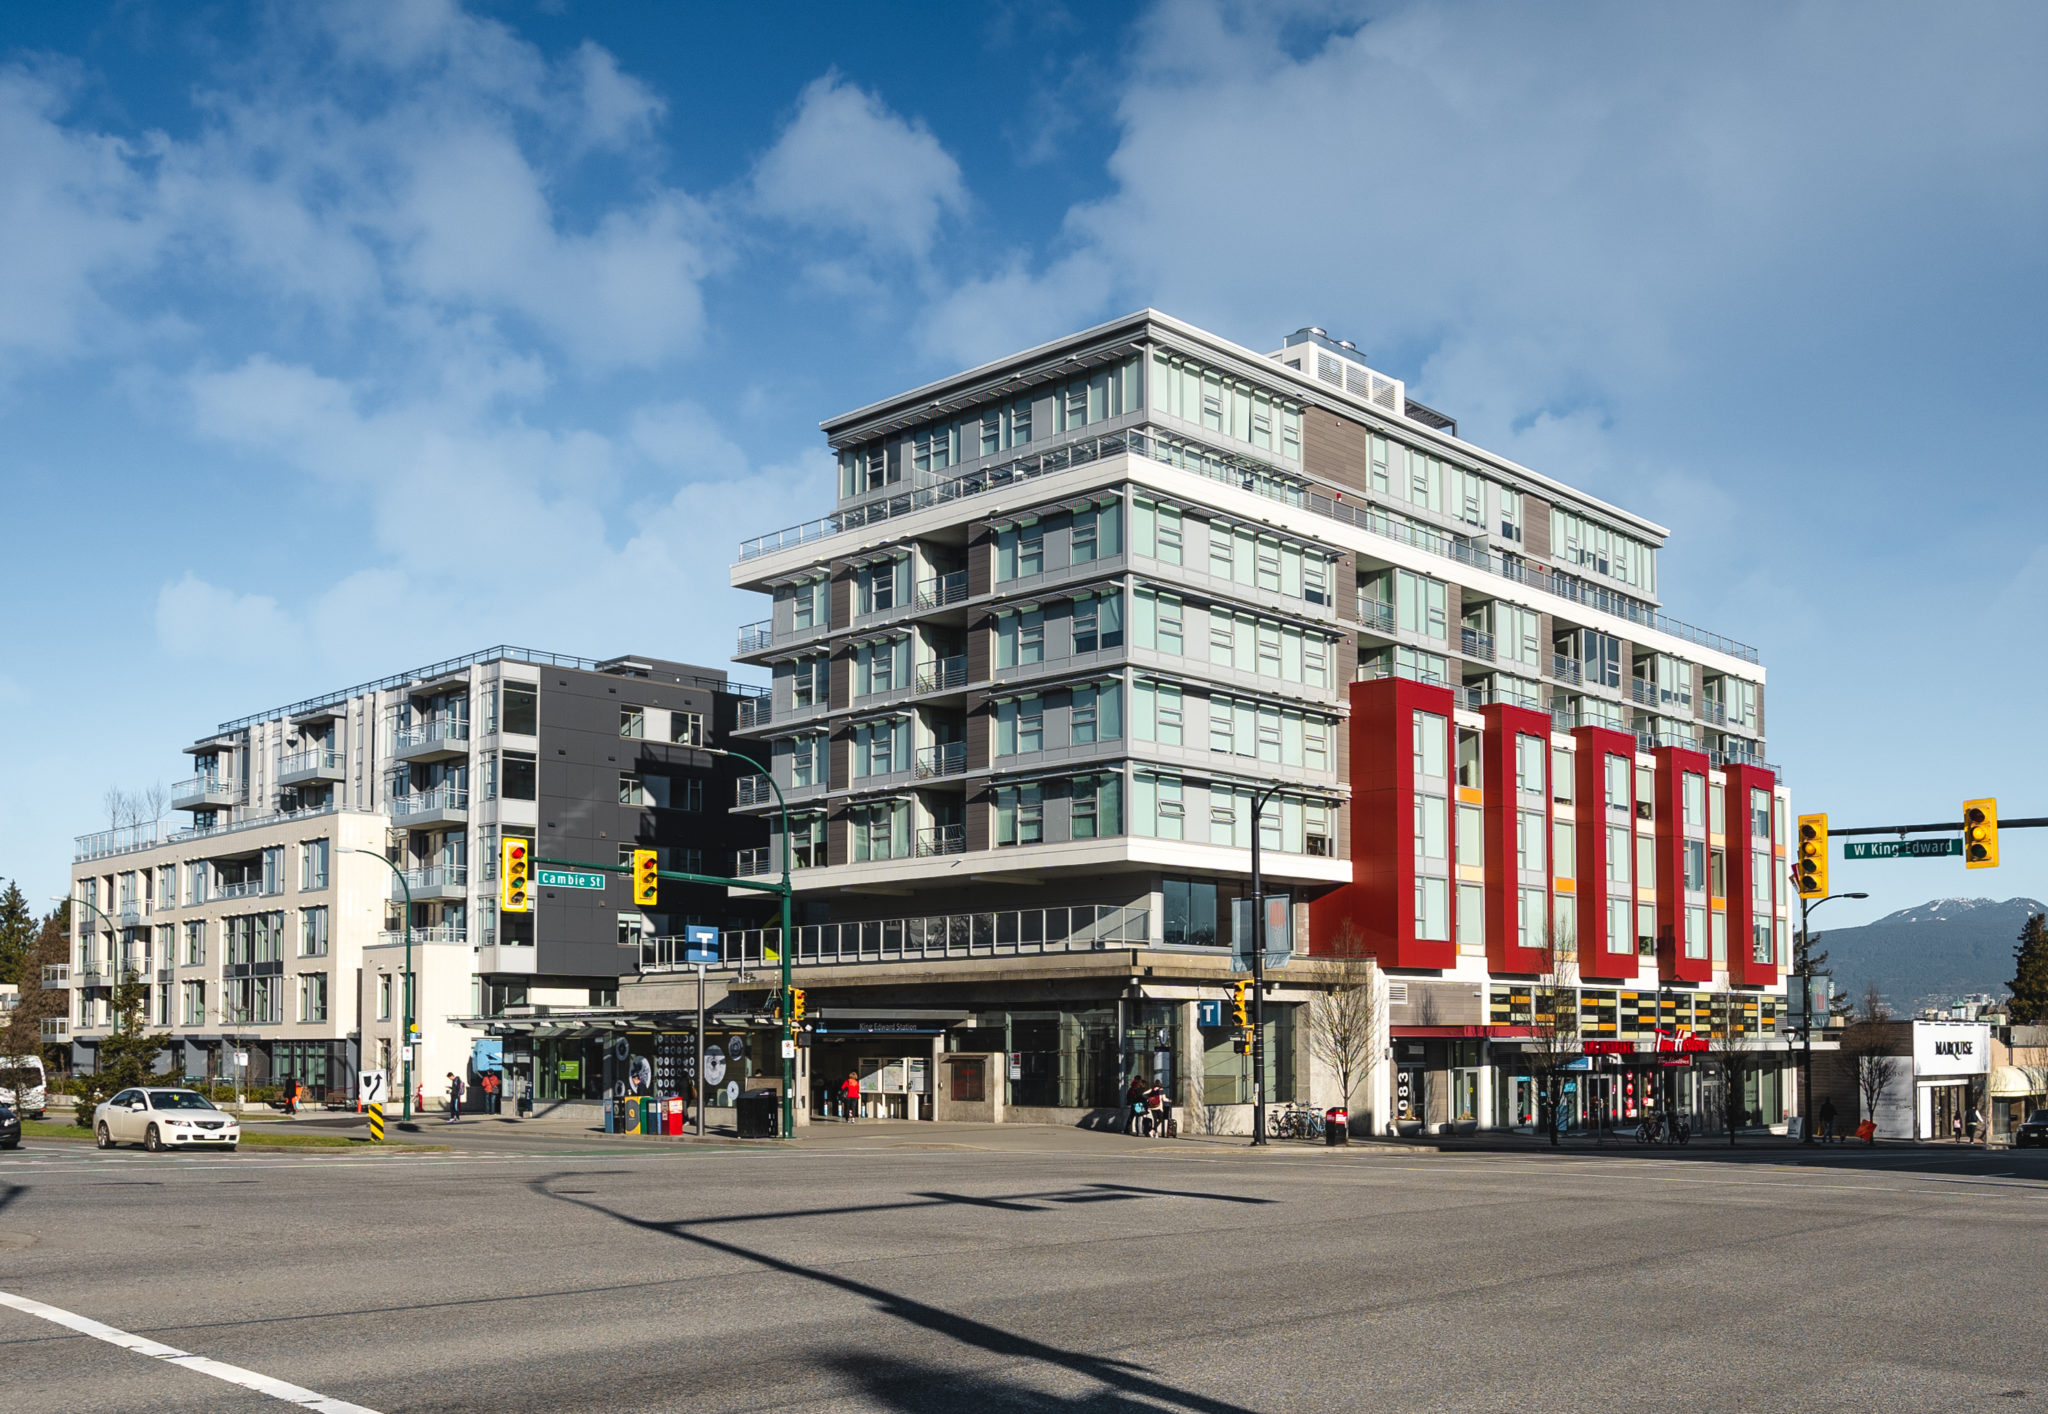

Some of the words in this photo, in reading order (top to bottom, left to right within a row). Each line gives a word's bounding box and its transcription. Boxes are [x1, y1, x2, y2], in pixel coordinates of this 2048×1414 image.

[1853, 844, 1866, 856] W
[1871, 842, 1900, 858] King
[1904, 840, 1953, 854] Edward
[542, 872, 585, 886] Cambie
[590, 876, 601, 887] St
[696, 932, 714, 957] T
[1202, 1004, 1215, 1023] T
[1934, 1041, 1974, 1061] MARQUISE
[1398, 1072, 1409, 1119] 083
